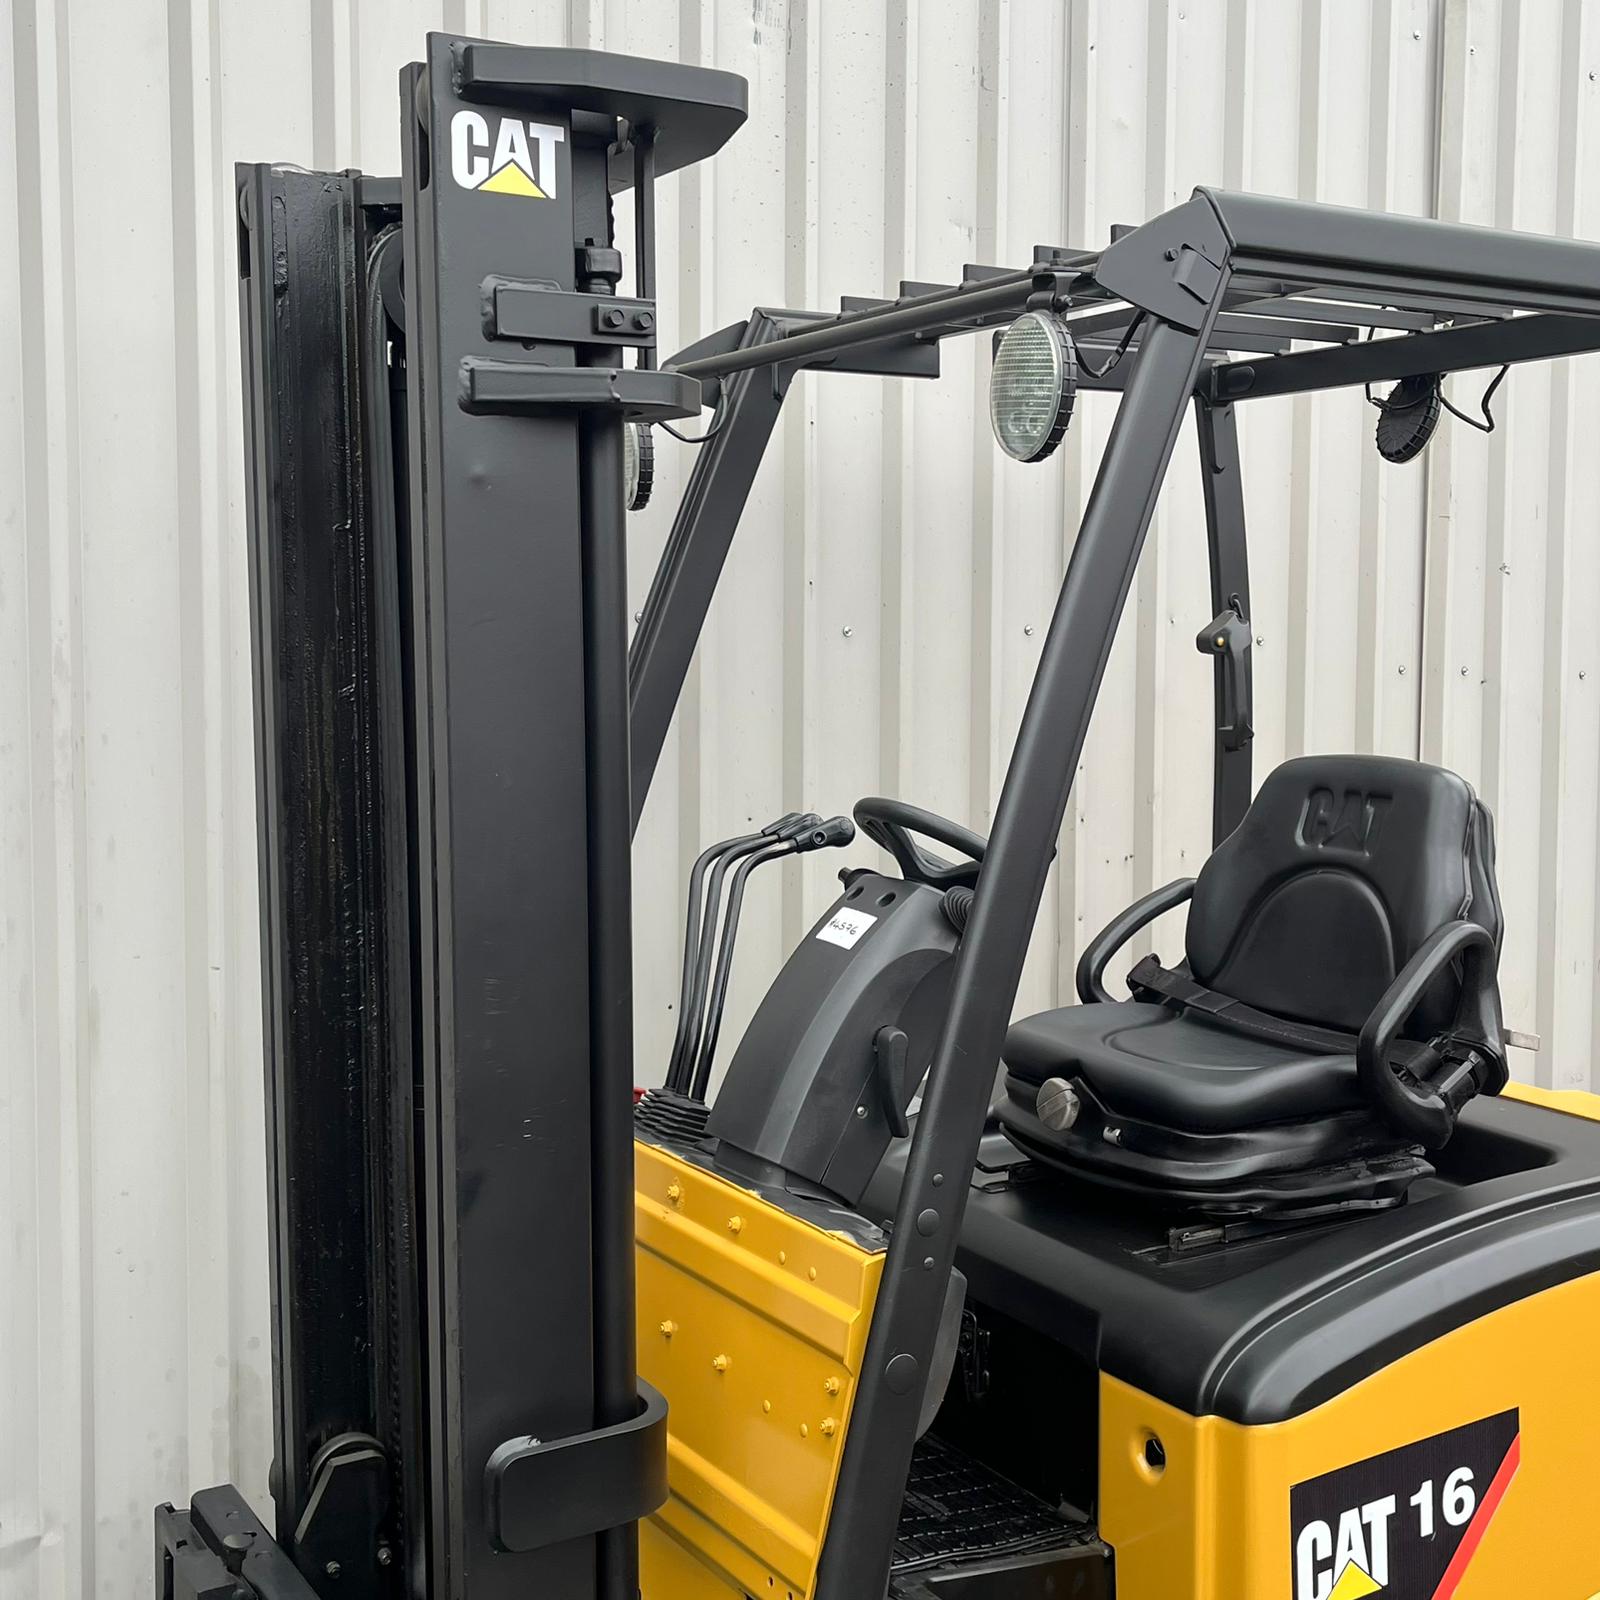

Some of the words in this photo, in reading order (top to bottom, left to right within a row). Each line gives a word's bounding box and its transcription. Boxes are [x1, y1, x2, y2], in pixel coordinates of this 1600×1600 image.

[451, 110, 564, 199] CAT
[1295, 784, 1394, 857] CAT
[1297, 1494, 1396, 1600] CAT
[1410, 1467, 1476, 1537] 16
